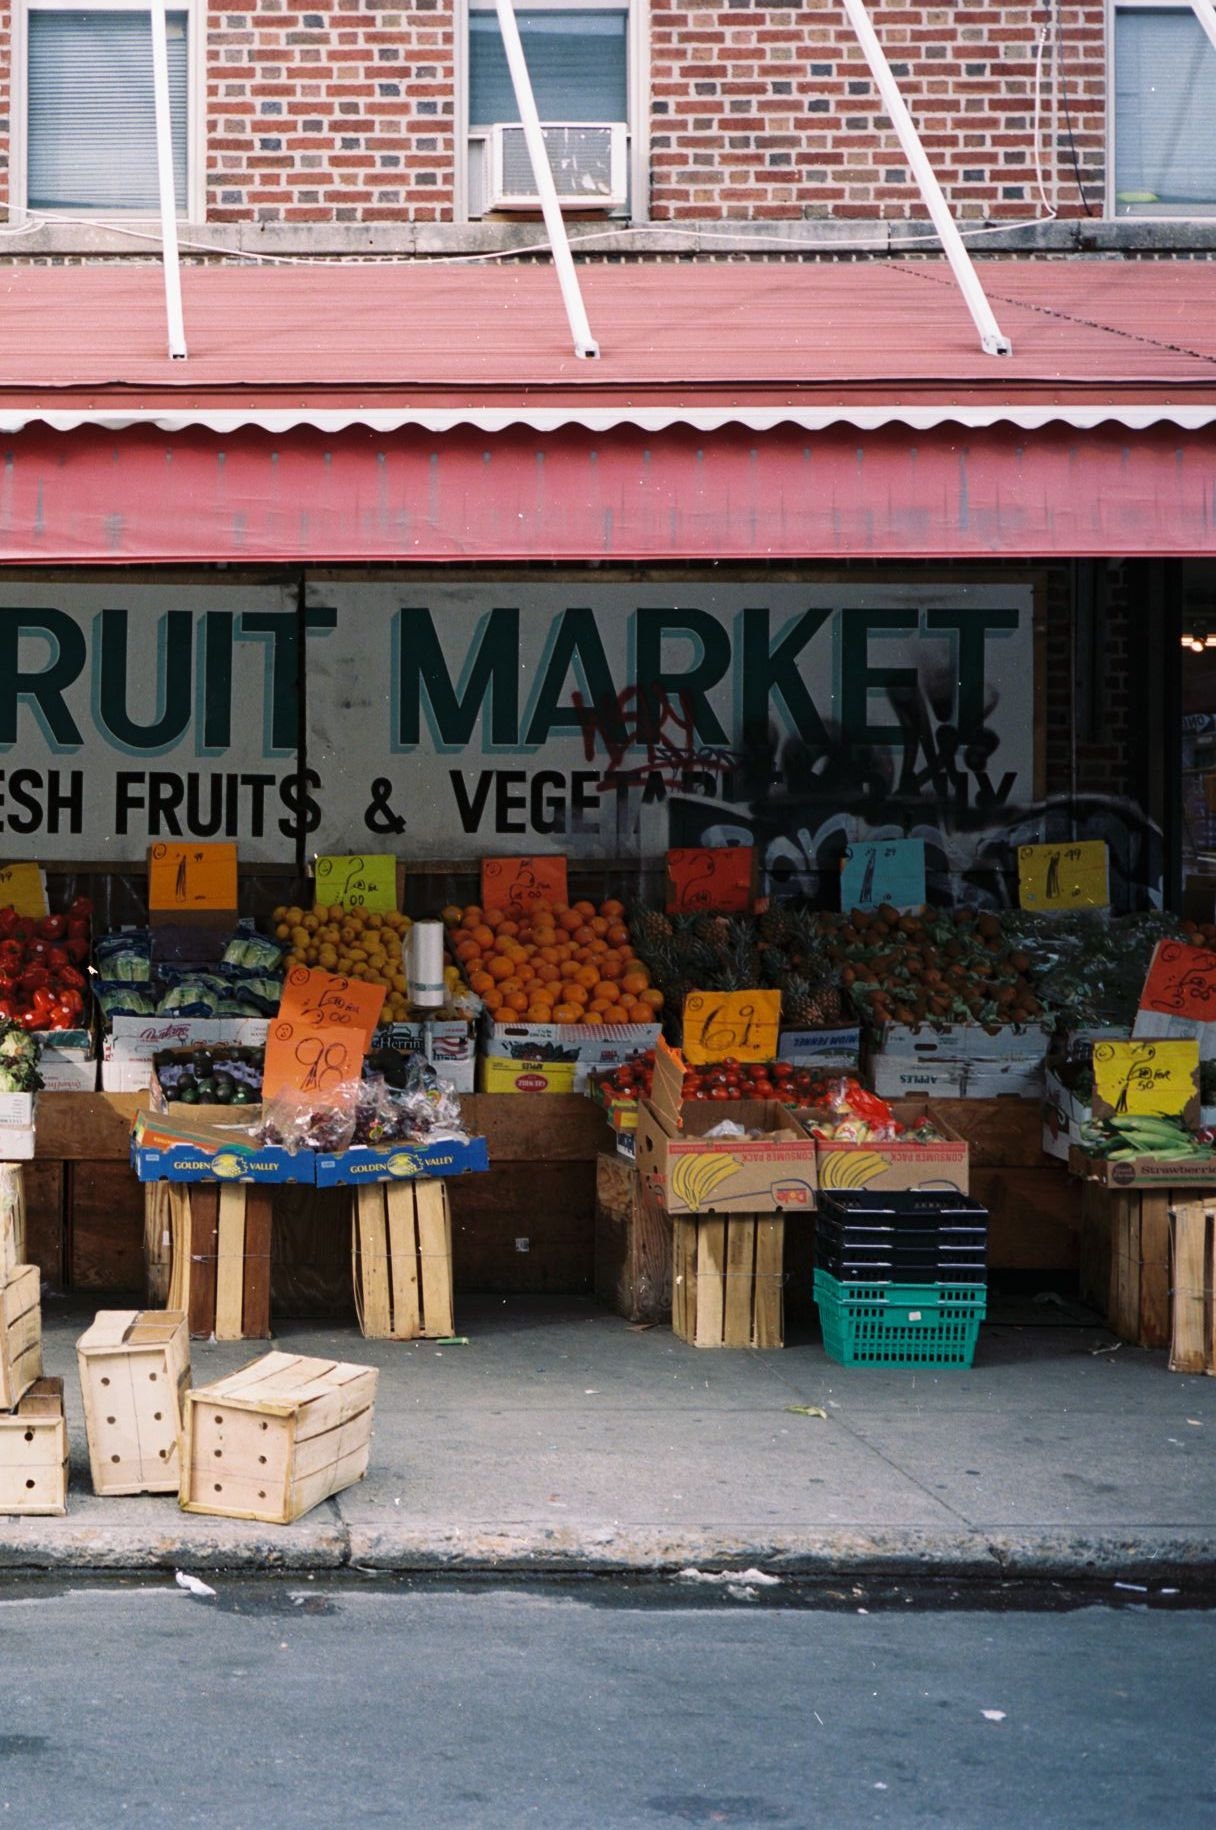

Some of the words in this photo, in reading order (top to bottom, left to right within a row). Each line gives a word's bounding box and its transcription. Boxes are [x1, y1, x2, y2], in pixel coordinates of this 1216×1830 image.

[390, 606, 1020, 756] MARKET
[115, 768, 322, 839] FRUITS
[364, 776, 407, 835] &
[899, 1074, 937, 1085] APPLES
[741, 1151, 764, 1163] PACK
[765, 1151, 814, 1162] CONSUMER
[890, 1152, 913, 1163] PACK
[914, 1151, 964, 1163] CONSUMER
[173, 1160, 212, 1171] GOLDEN
[248, 1160, 280, 1172] VALLEY
[349, 1162, 388, 1175] GOLDEN
[423, 1155, 454, 1168] VALLEY
[776, 1189, 807, 1204] Dole
